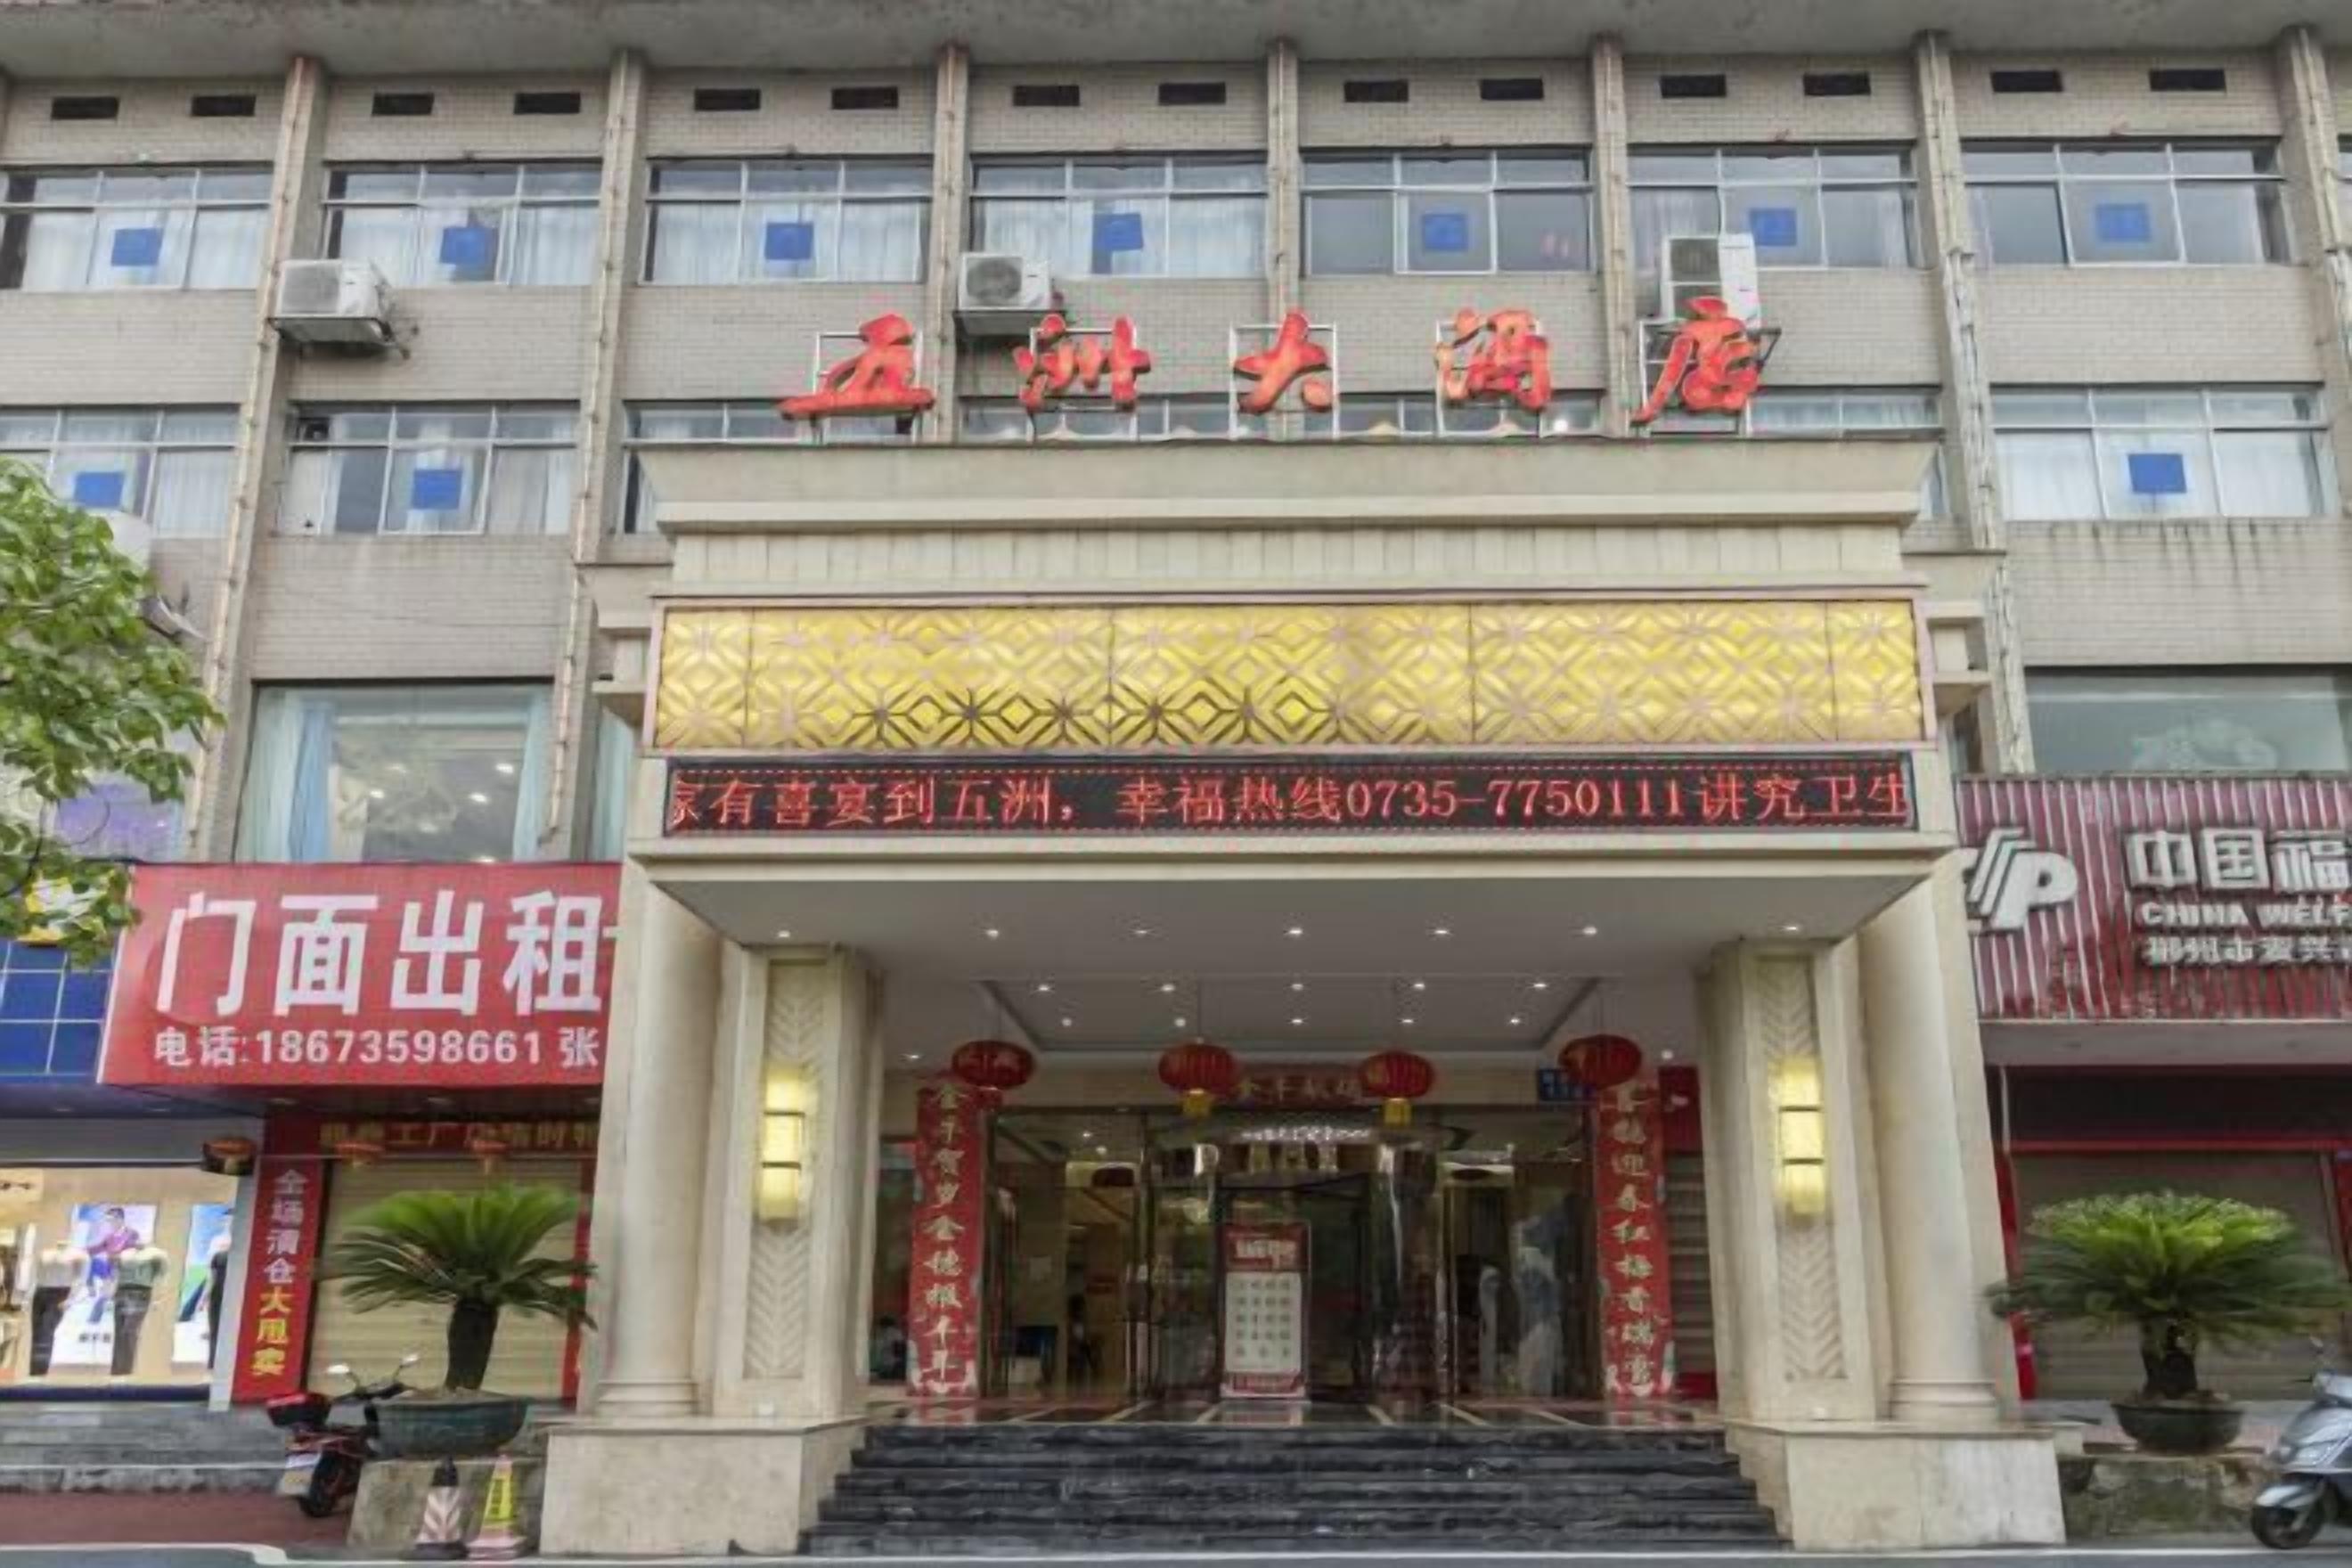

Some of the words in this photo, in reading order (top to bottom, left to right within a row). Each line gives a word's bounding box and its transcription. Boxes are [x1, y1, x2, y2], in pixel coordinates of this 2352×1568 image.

[778, 296, 1761, 426] 五洲大酒店
[156, 889, 624, 1017] 门面出租
[2142, 902, 2250, 927] CHINA
[558, 1025, 599, 1069] 张
